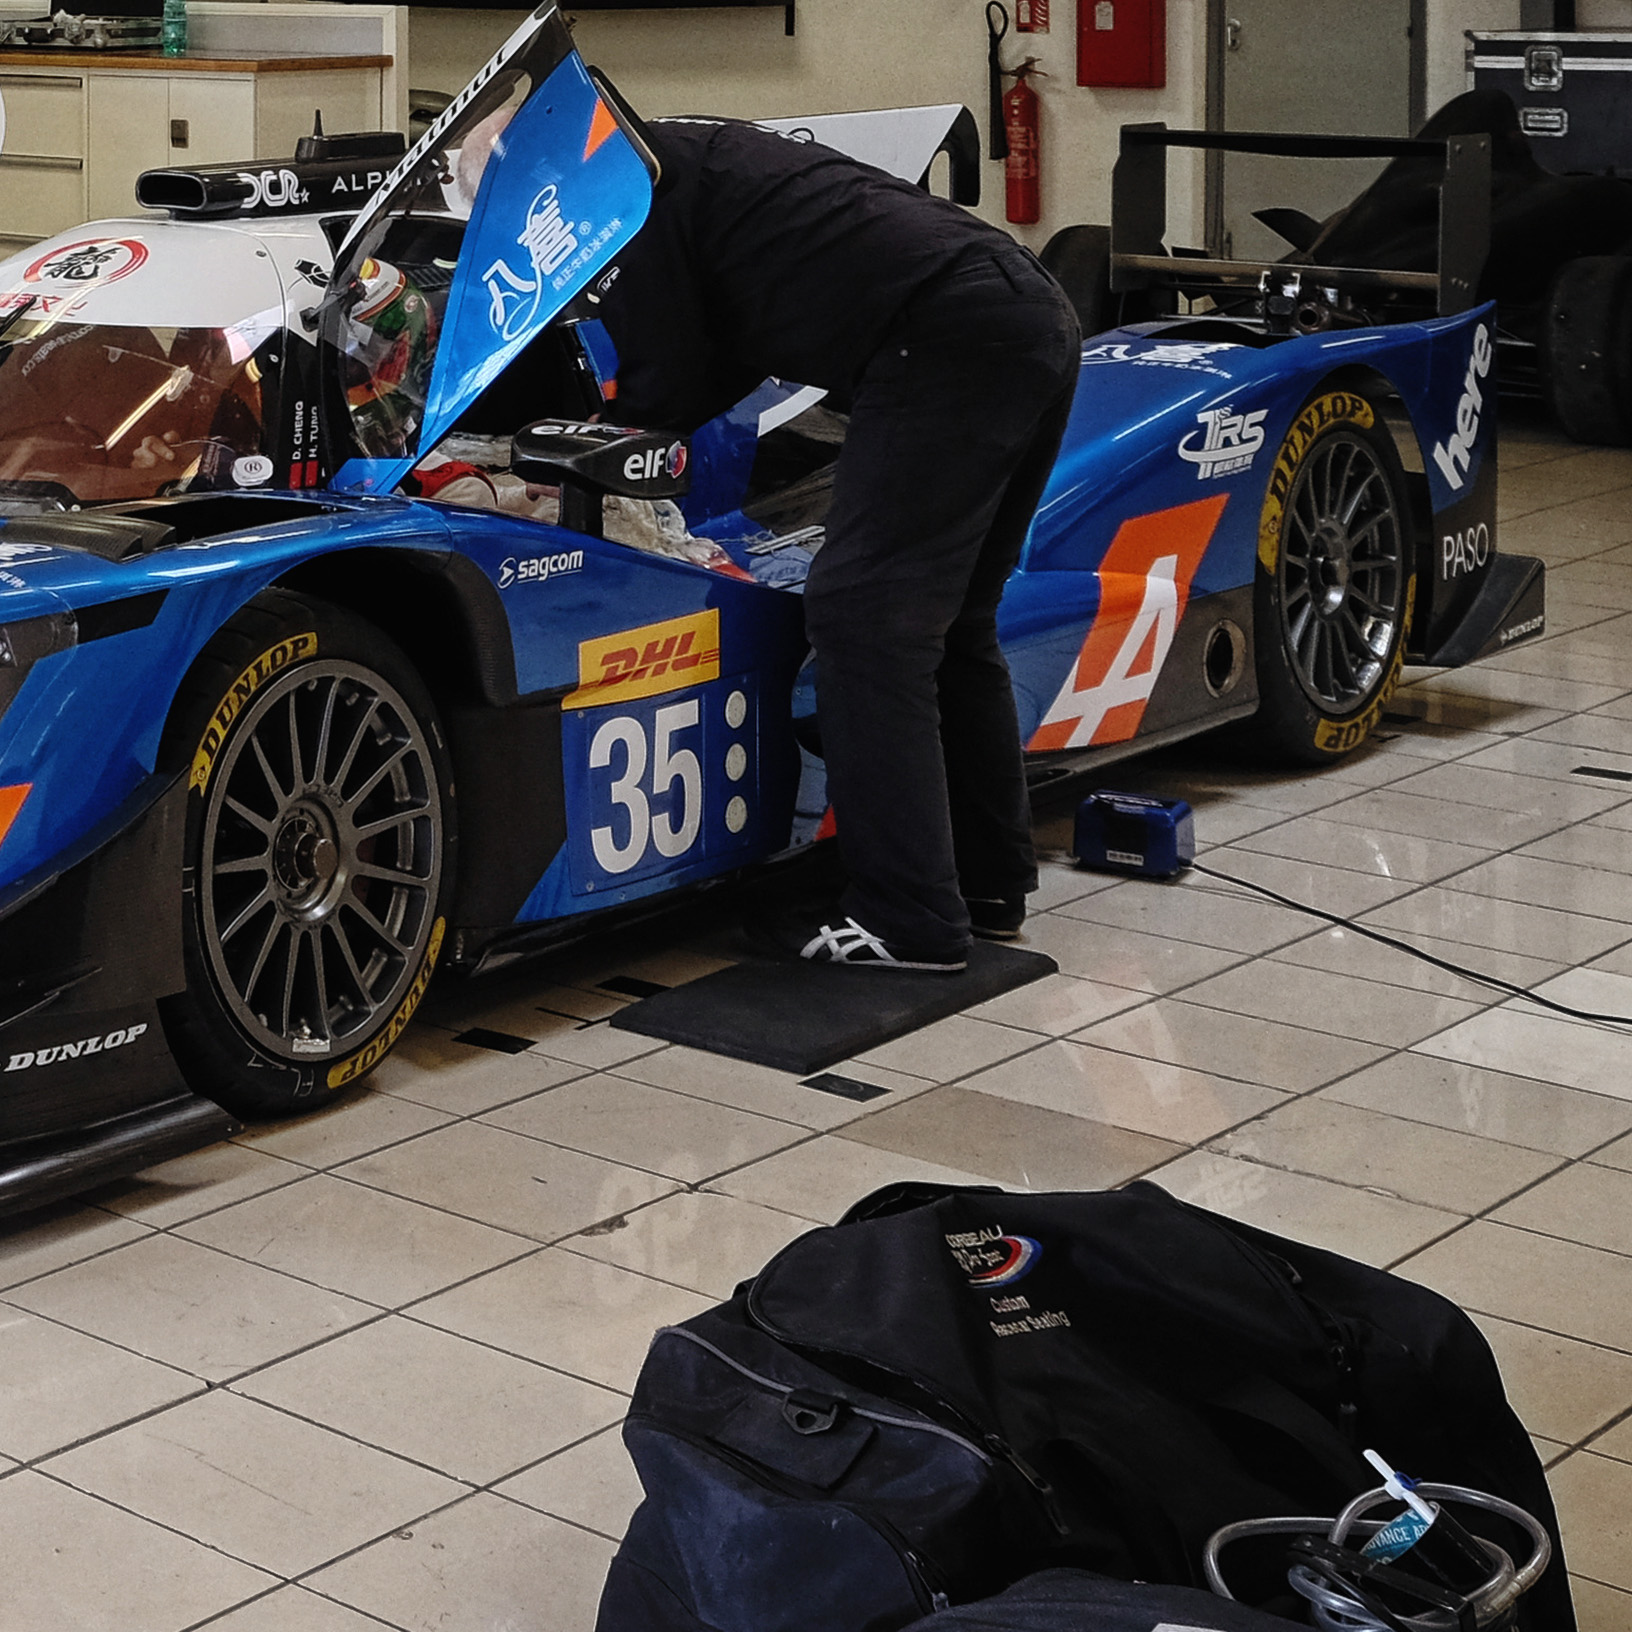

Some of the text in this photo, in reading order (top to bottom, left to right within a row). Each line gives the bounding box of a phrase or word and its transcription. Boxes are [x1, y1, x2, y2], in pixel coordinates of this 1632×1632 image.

[331, 169, 384, 195] ALP
[1433, 323, 1493, 491] here
[623, 447, 666, 481] elf
[1269, 394, 1366, 502] DUNLOP
[518, 550, 584, 581] sagcom
[1443, 522, 1489, 581] PASO
[597, 630, 720, 688] DHL
[203, 635, 311, 770] DUNLOP
[589, 699, 703, 875] 35
[4, 1023, 148, 1074] DUNLOP
[944, 1224, 1003, 1249] CORBEAU
[989, 1295, 1031, 1313] Custom
[1026, 1310, 1071, 1330] Seating
[1367, 1526, 1412, 1550] DVANCE
